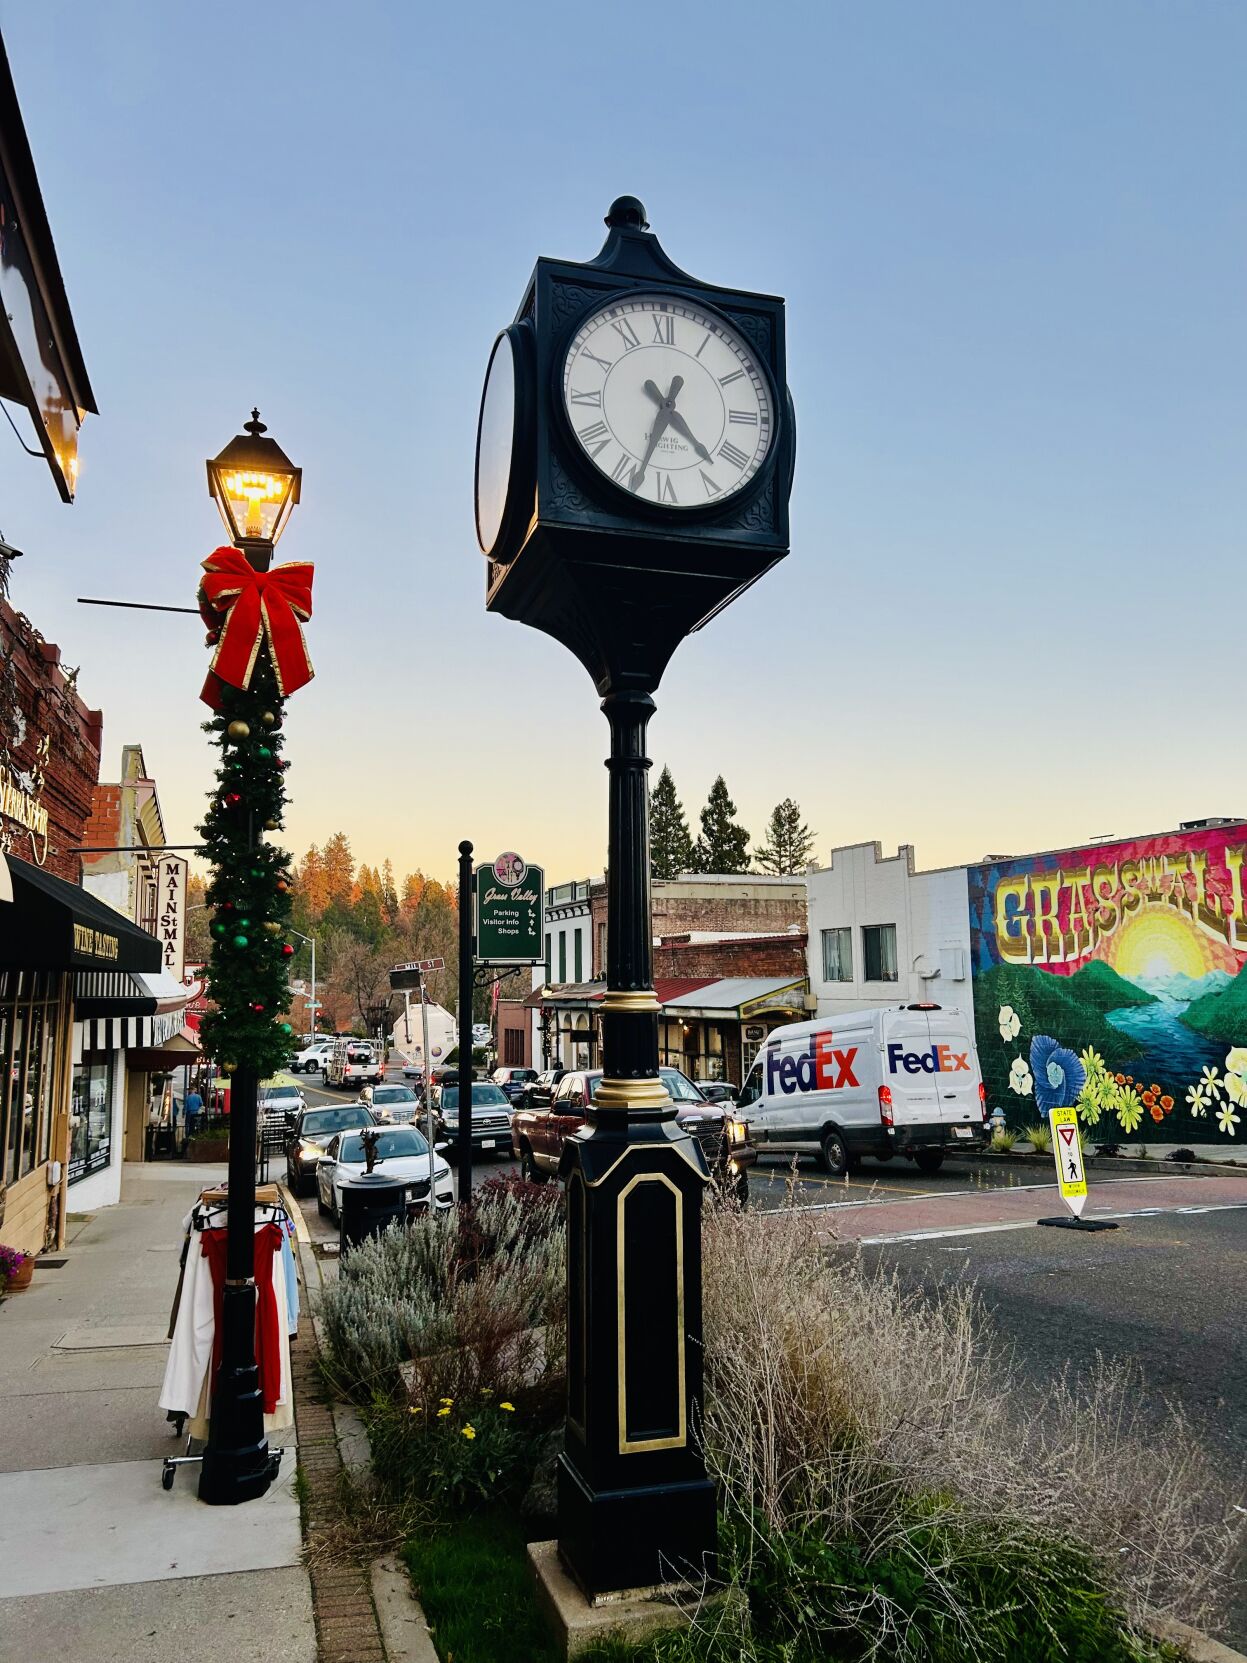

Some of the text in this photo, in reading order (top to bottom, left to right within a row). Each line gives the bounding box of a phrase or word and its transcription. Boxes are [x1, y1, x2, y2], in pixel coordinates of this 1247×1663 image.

[611, 318, 641, 351] XI
[652, 313, 676, 346] XII
[581, 346, 612, 373] X
[718, 369, 746, 388] II
[729, 409, 758, 426] III
[656, 471, 679, 504] VI
[699, 469, 723, 497] V
[483, 887, 539, 906] Grass Valley
[161, 863, 180, 969] MAIN St MAL
[482, 918, 520, 926] Visitor Info
[493, 909, 520, 918] Parking
[994, 857, 1144, 965] GRASS
[73, 923, 119, 959] WINE TASTING
[497, 927, 520, 936] Shops
[427, 960, 435, 968] ST
[766, 1029, 861, 1096] FedEx
[887, 1043, 971, 1074] FedEx
[1056, 1109, 1073, 1117] STATE
